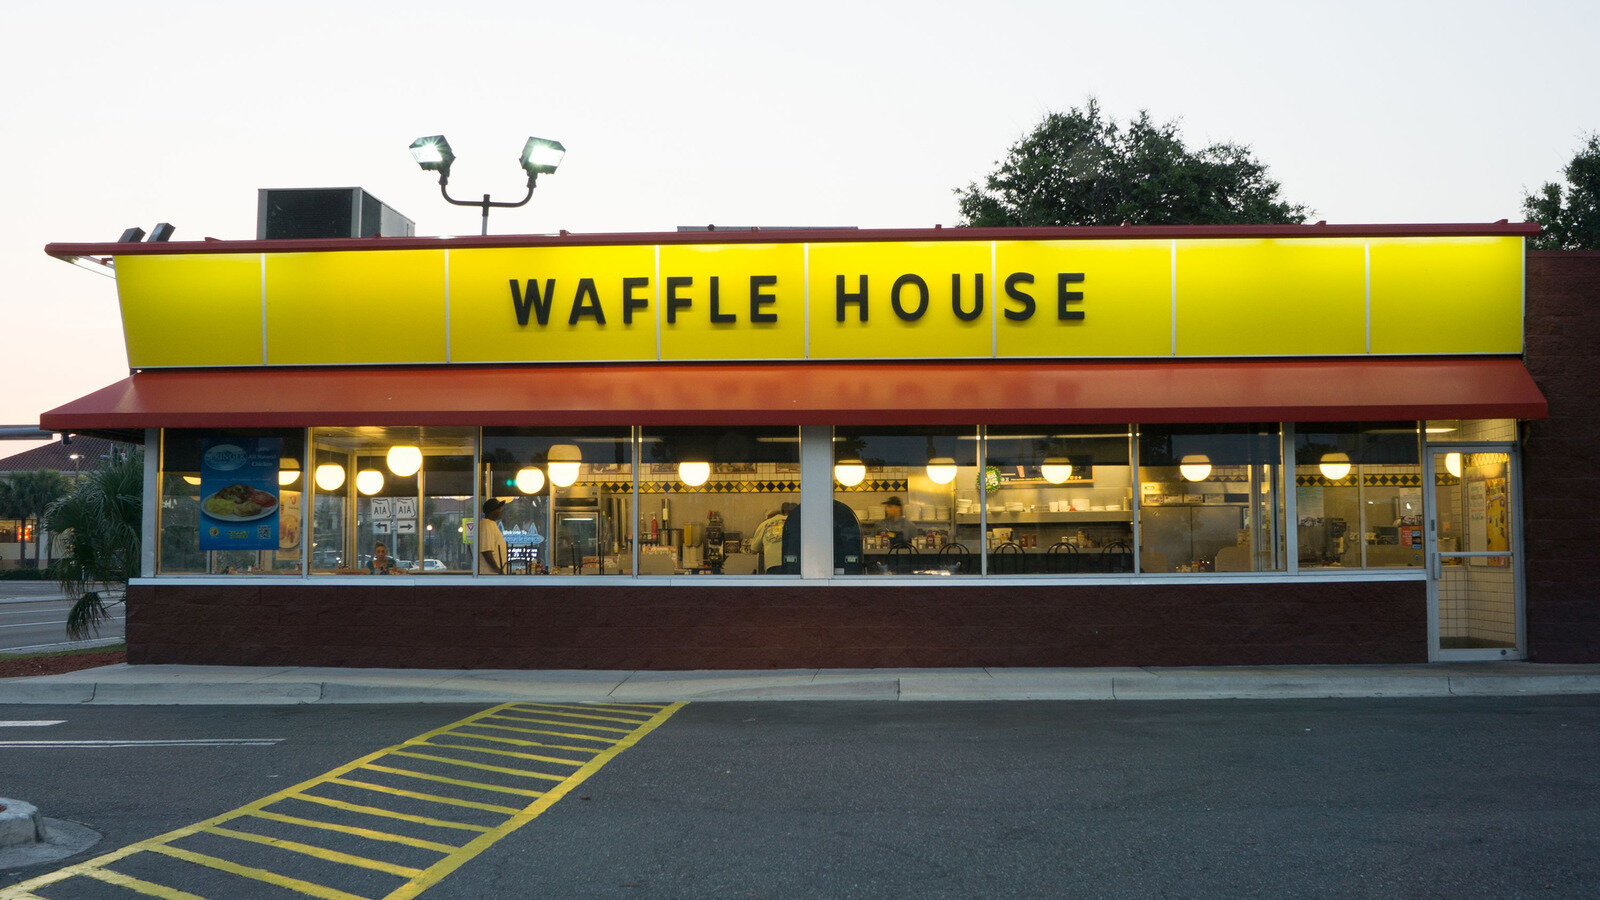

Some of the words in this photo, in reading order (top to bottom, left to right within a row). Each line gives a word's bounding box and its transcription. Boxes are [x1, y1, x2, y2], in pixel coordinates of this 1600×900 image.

[509, 275, 778, 326] WAFFLE
[835, 272, 1086, 323] HOUSE
[374, 506, 387, 515] A1A
[398, 505, 412, 514] A1A
